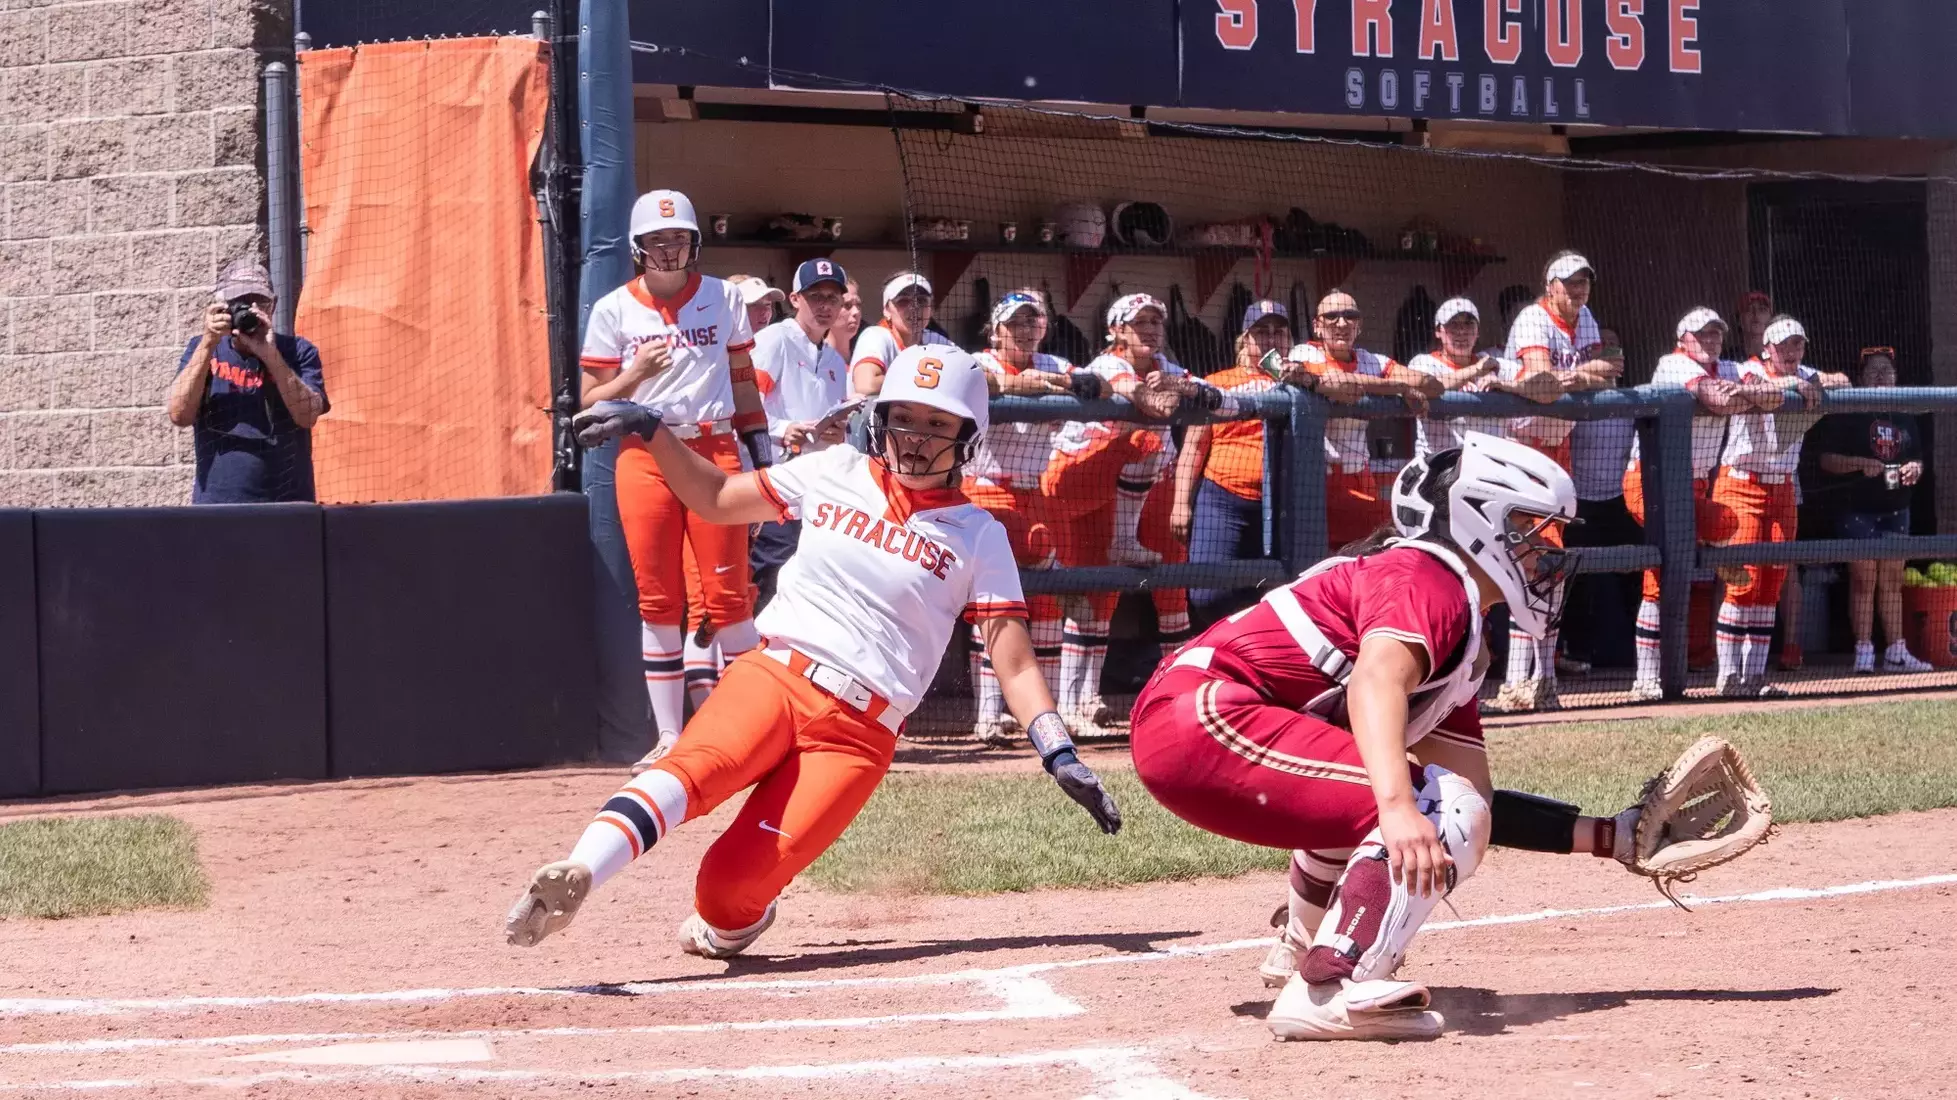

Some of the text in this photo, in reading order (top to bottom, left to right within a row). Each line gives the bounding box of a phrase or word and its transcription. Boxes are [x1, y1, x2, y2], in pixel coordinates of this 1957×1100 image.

[1215, 0, 1702, 74] SYRACUSE
[1345, 67, 1591, 118] SOFTBALL
[658, 198, 675, 218] S
[914, 356, 944, 389] S
[813, 502, 956, 581] SYRACUSE
